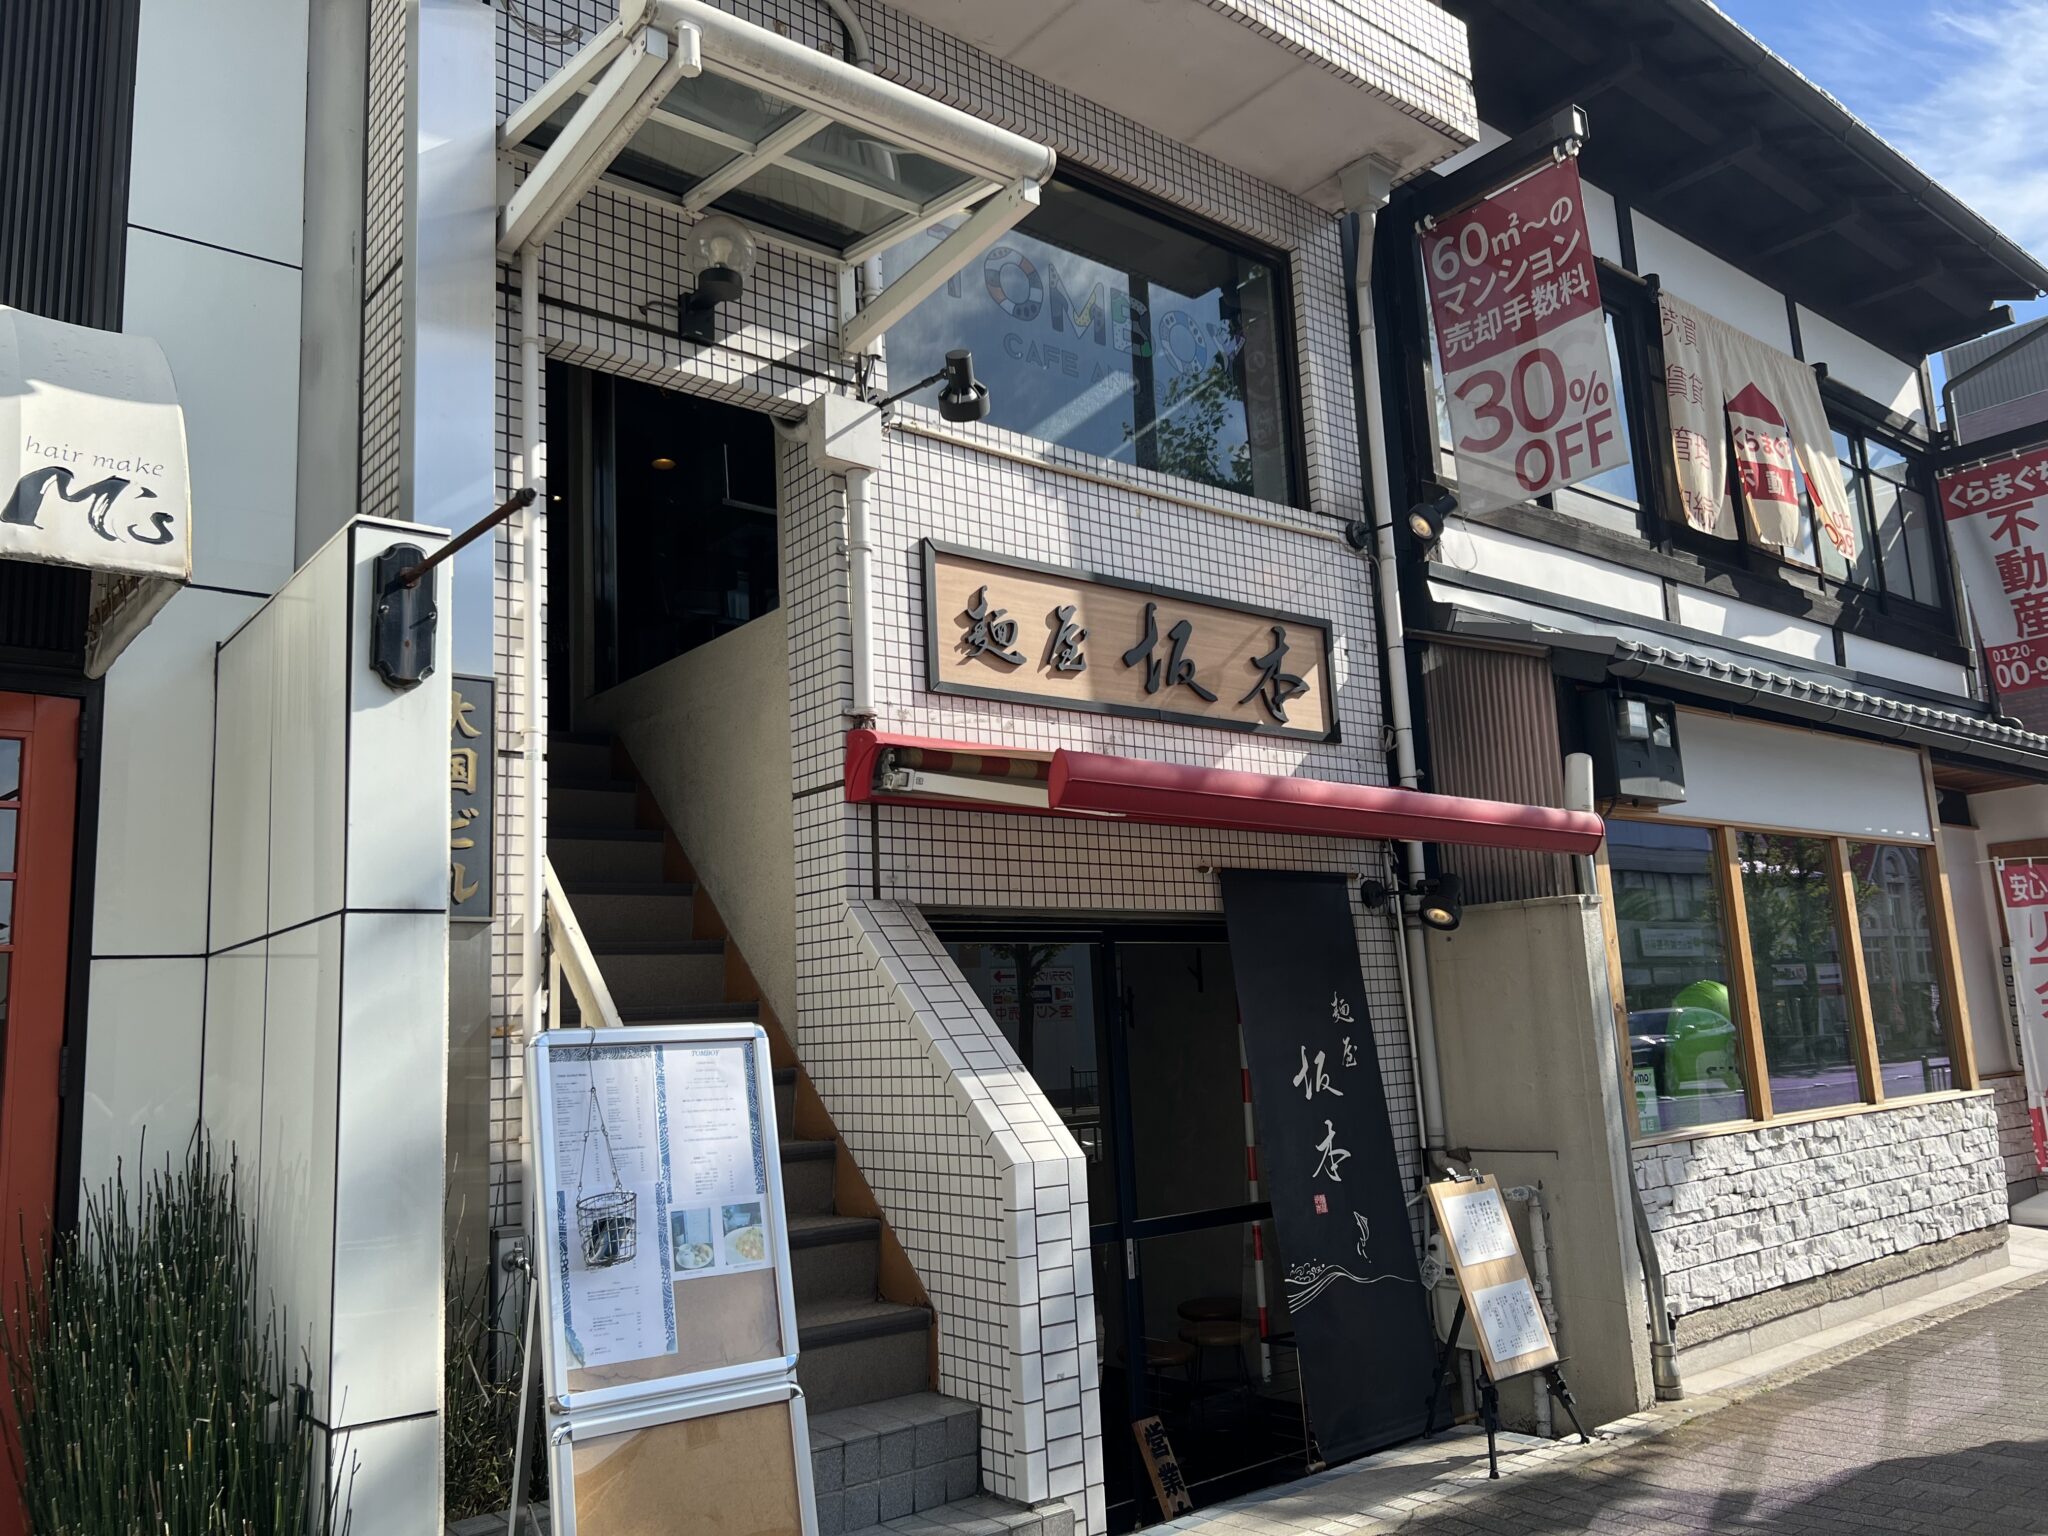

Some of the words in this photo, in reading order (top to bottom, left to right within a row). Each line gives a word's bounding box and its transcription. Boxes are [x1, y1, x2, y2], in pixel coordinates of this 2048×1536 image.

[1437, 229, 1582, 317] マンション
[1443, 264, 1591, 359] 売却手数料
[1003, 332, 1080, 379] CAFE
[1454, 347, 1609, 454] 30%
[1733, 425, 1791, 460] くらまぐ
[25, 435, 83, 464] hair
[92, 455, 164, 477] make
[1515, 409, 1613, 493] OFF
[1, 466, 175, 546] M's
[1987, 500, 2048, 639] 不動産
